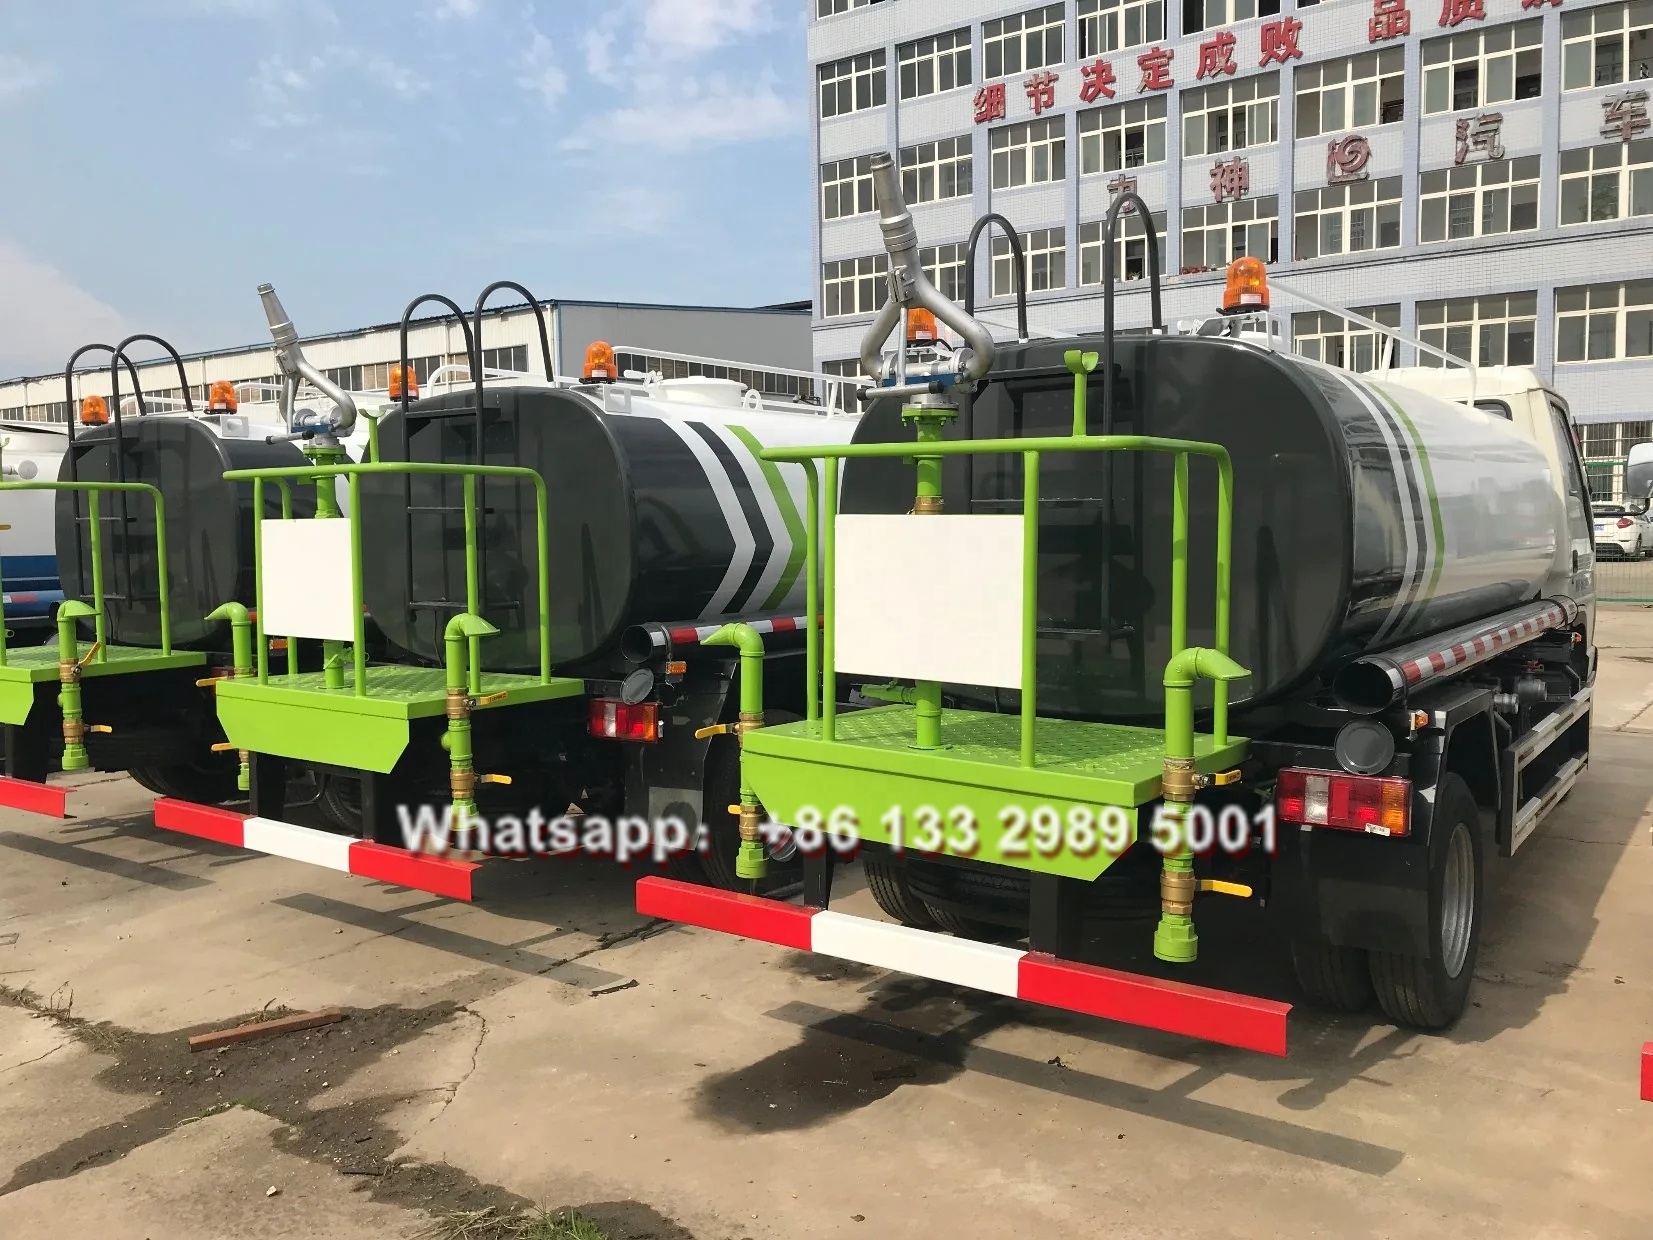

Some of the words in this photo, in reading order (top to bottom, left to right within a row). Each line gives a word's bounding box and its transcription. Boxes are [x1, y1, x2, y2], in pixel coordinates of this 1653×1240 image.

[973, 18, 1304, 124] 细节决定成败
[1369, 0, 1564, 44] 品质
[1455, 90, 1652, 165] 汽车
